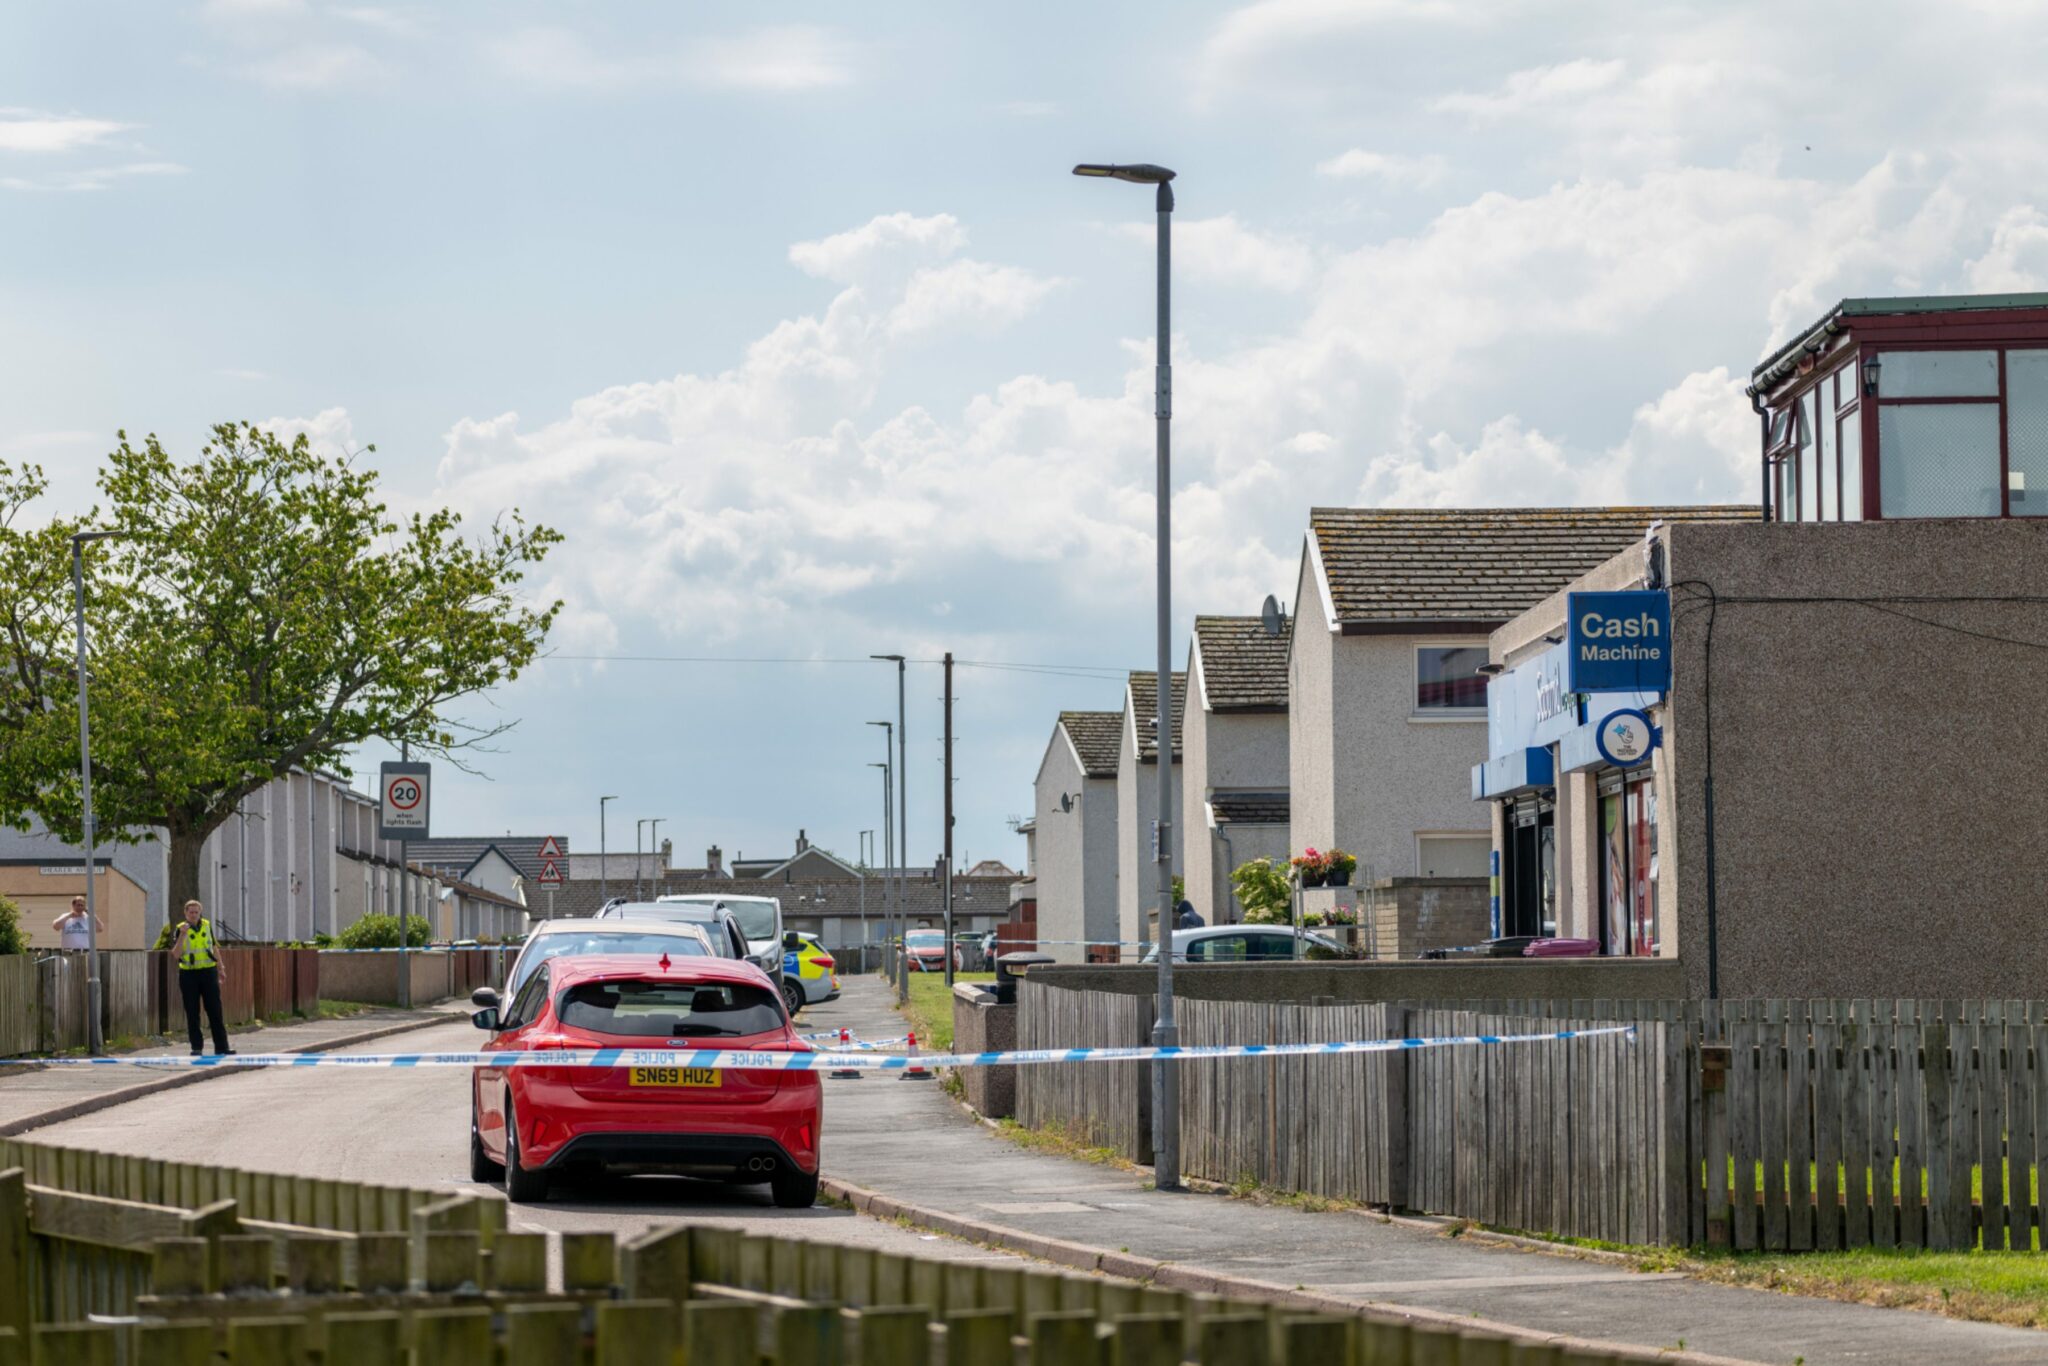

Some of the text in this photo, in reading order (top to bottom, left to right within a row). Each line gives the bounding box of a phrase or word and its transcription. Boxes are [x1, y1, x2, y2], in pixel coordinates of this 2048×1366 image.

[1580, 612, 1659, 639] Cash
[1581, 644, 1661, 661] Machine
[394, 787, 417, 801] 20
[636, 1068, 715, 1084] SN69 HUZ
